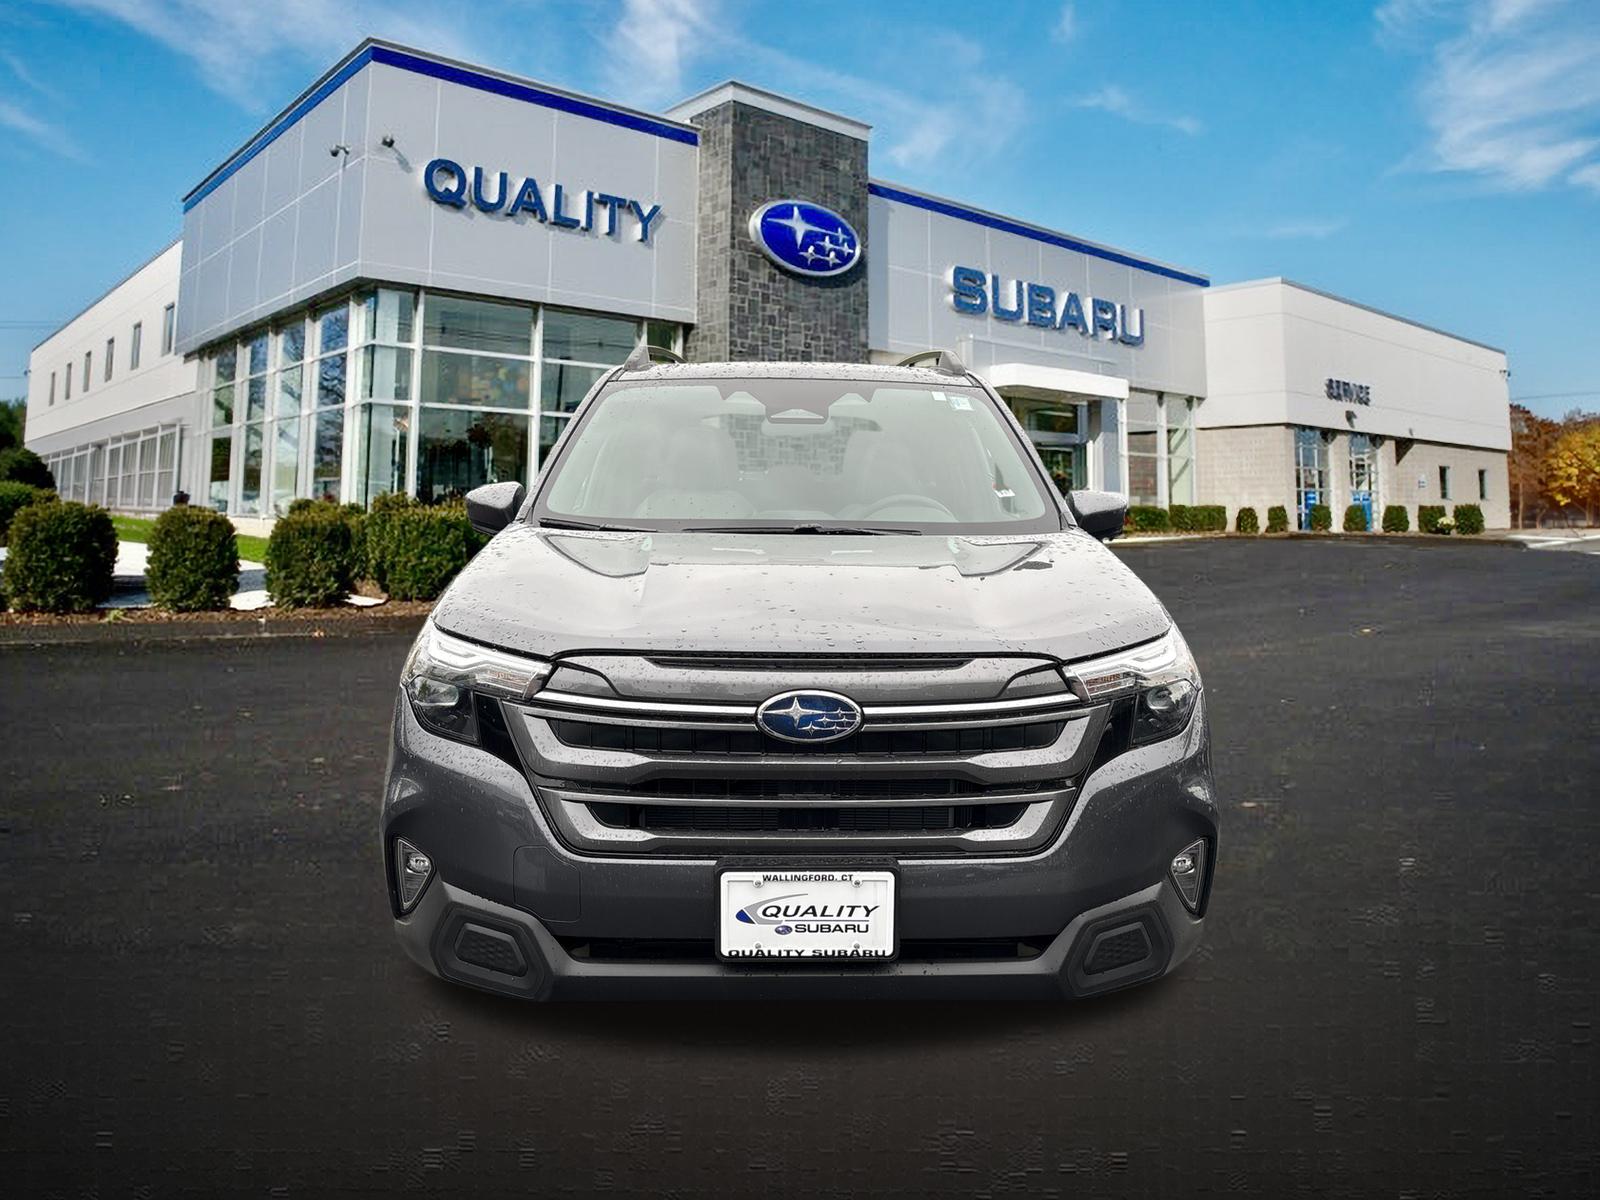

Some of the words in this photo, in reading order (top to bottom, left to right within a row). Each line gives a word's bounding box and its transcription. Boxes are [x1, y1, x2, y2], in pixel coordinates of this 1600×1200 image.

[424, 158, 662, 242] QUALITY
[951, 265, 1144, 346] SUBARU
[841, 874, 854, 882] CT
[761, 905, 880, 918] QUALITY
[794, 924, 869, 933] SUBARU
[728, 949, 805, 957] QUALITY
[812, 949, 886, 957] SUBARU
